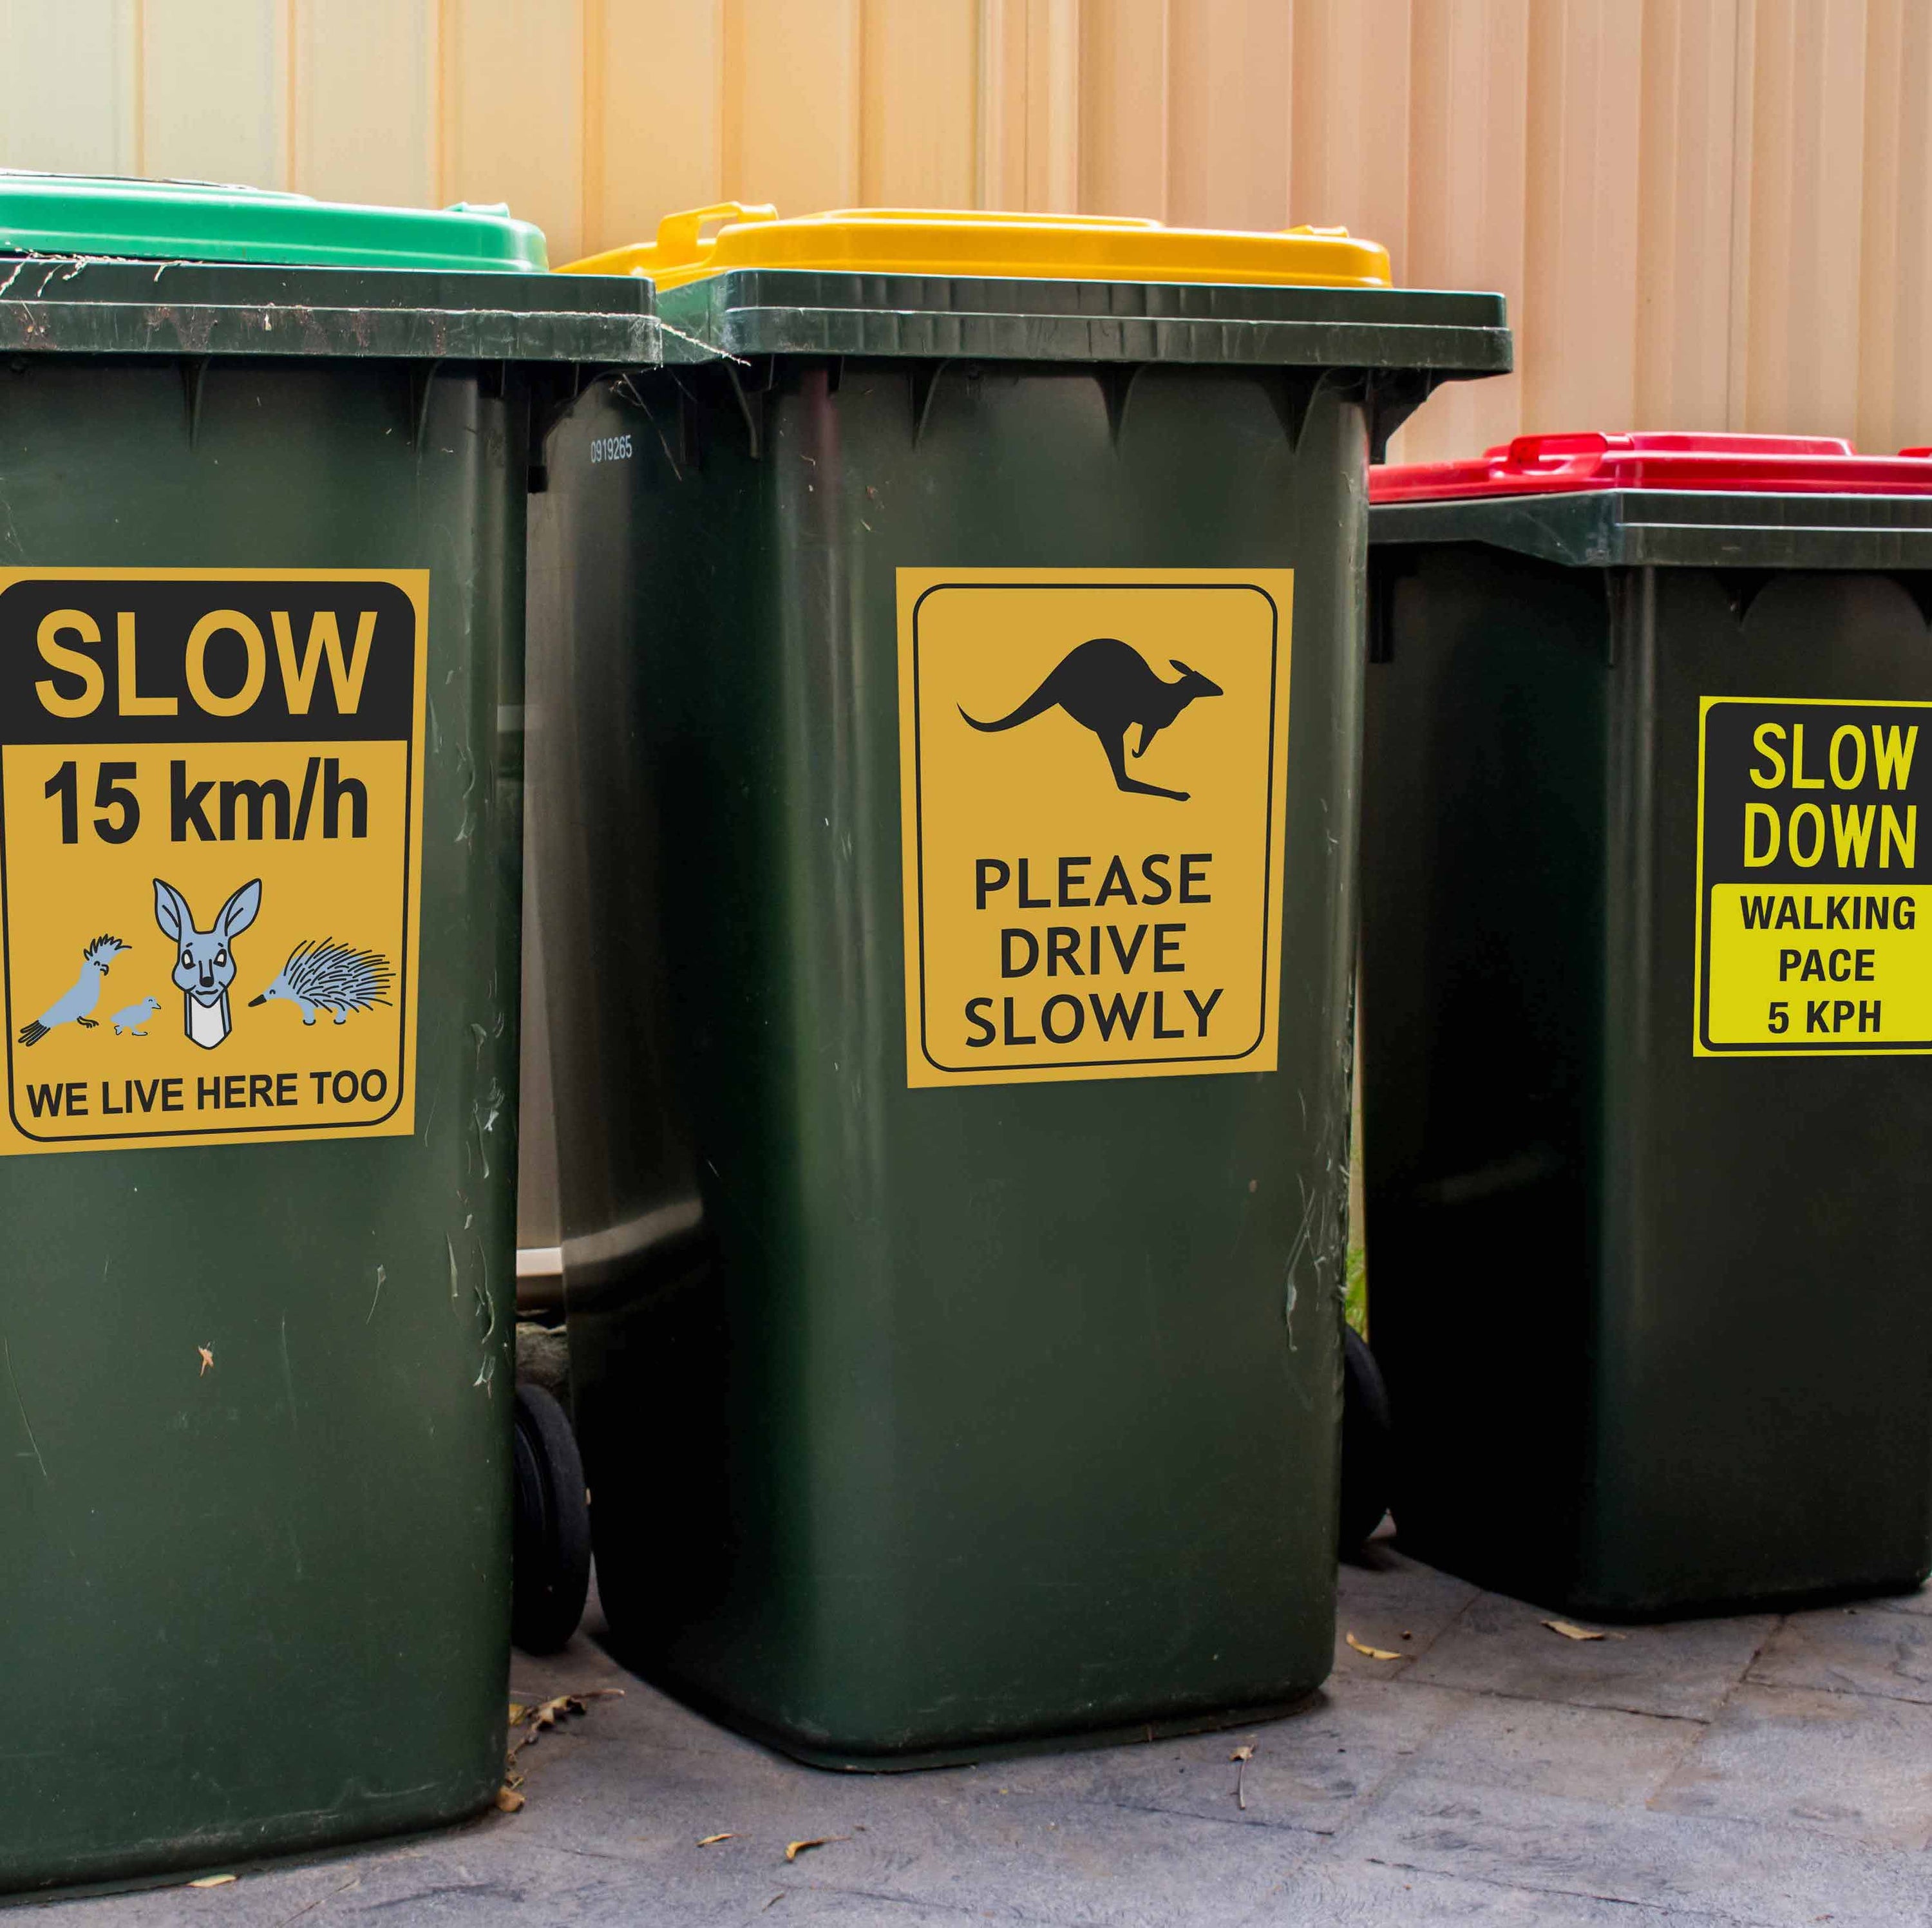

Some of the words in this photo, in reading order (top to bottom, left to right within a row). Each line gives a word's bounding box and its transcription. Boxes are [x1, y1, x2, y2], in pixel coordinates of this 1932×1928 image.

[591, 435, 632, 463] 0919265
[35, 609, 377, 717] SLOW
[1750, 723, 1918, 790] SLOW
[45, 762, 140, 844] 15
[171, 757, 367, 841] km/h
[1745, 803, 1917, 868] DOWN
[976, 854, 1212, 909] PLEASE
[1741, 896, 1915, 929] WALKING
[1001, 923, 1186, 978] DRIVE
[1780, 949, 1875, 981] PACE
[965, 989, 1224, 1047] SLOWLY
[1768, 1002, 1788, 1034] 5
[1807, 1001, 1880, 1032] KPH
[26, 1082, 88, 1117] WE
[102, 1079, 183, 1114] LIVE
[198, 1073, 298, 1110] HERE
[310, 1069, 386, 1104] TOO
